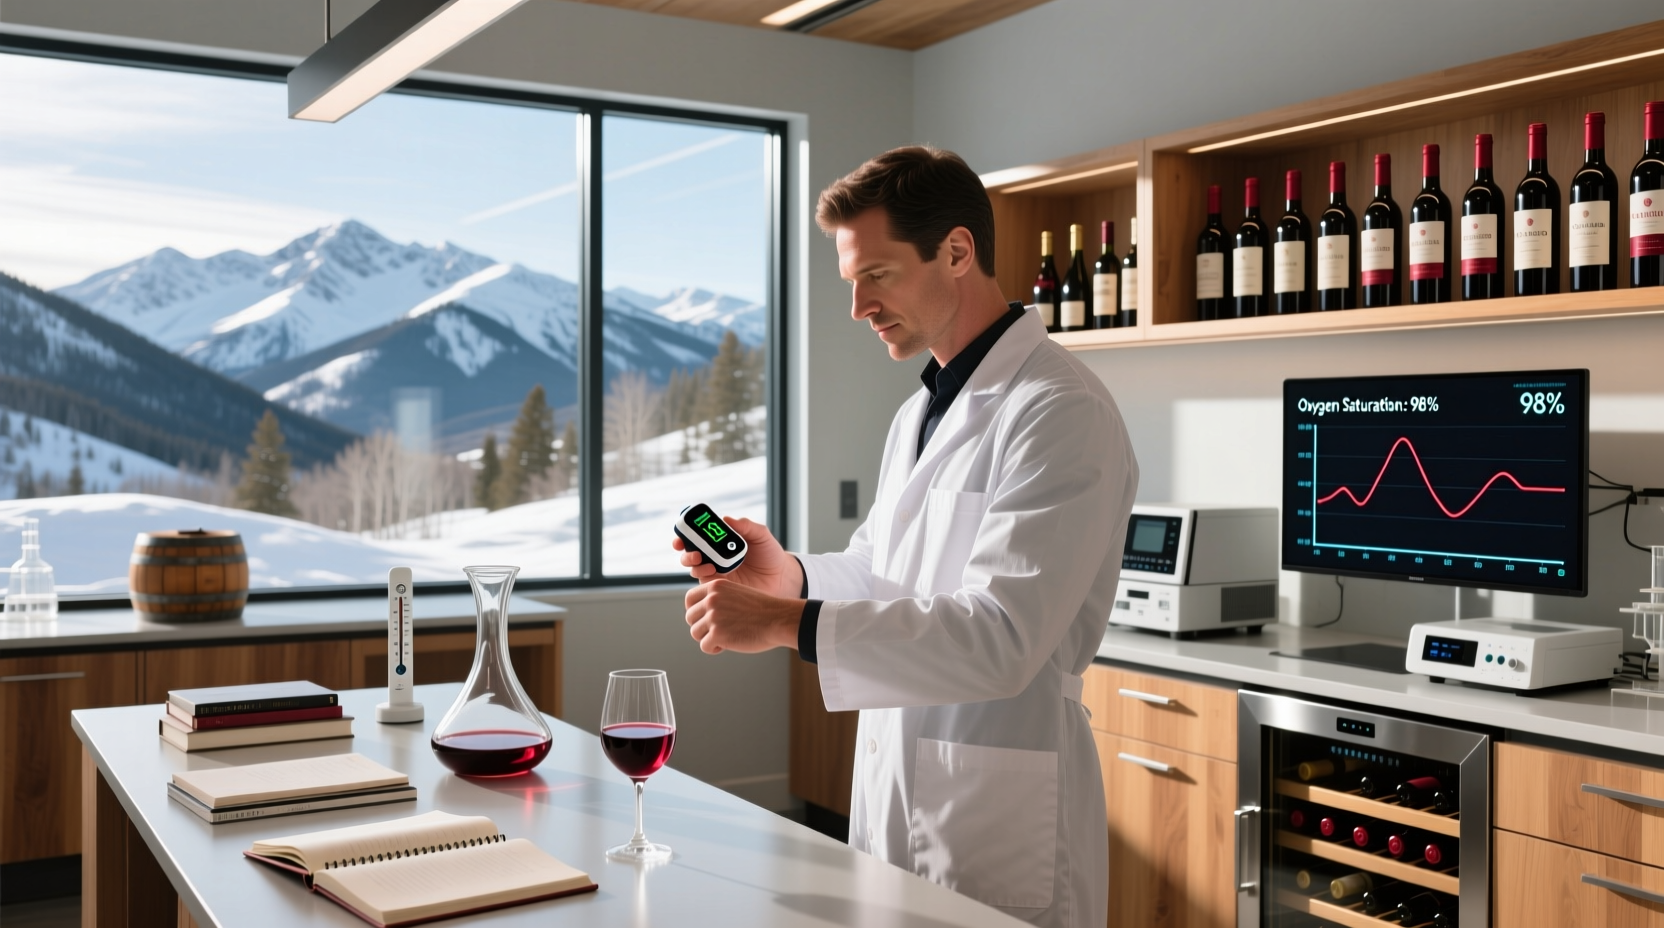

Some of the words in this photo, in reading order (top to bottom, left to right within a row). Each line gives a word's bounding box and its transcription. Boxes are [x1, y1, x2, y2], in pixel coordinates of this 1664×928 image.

[1298, 397, 1339, 416] Oxygen
[1342, 397, 1408, 412] Saturation:
[1410, 396, 1439, 412] 98%
[1520, 392, 1565, 414] 98%
